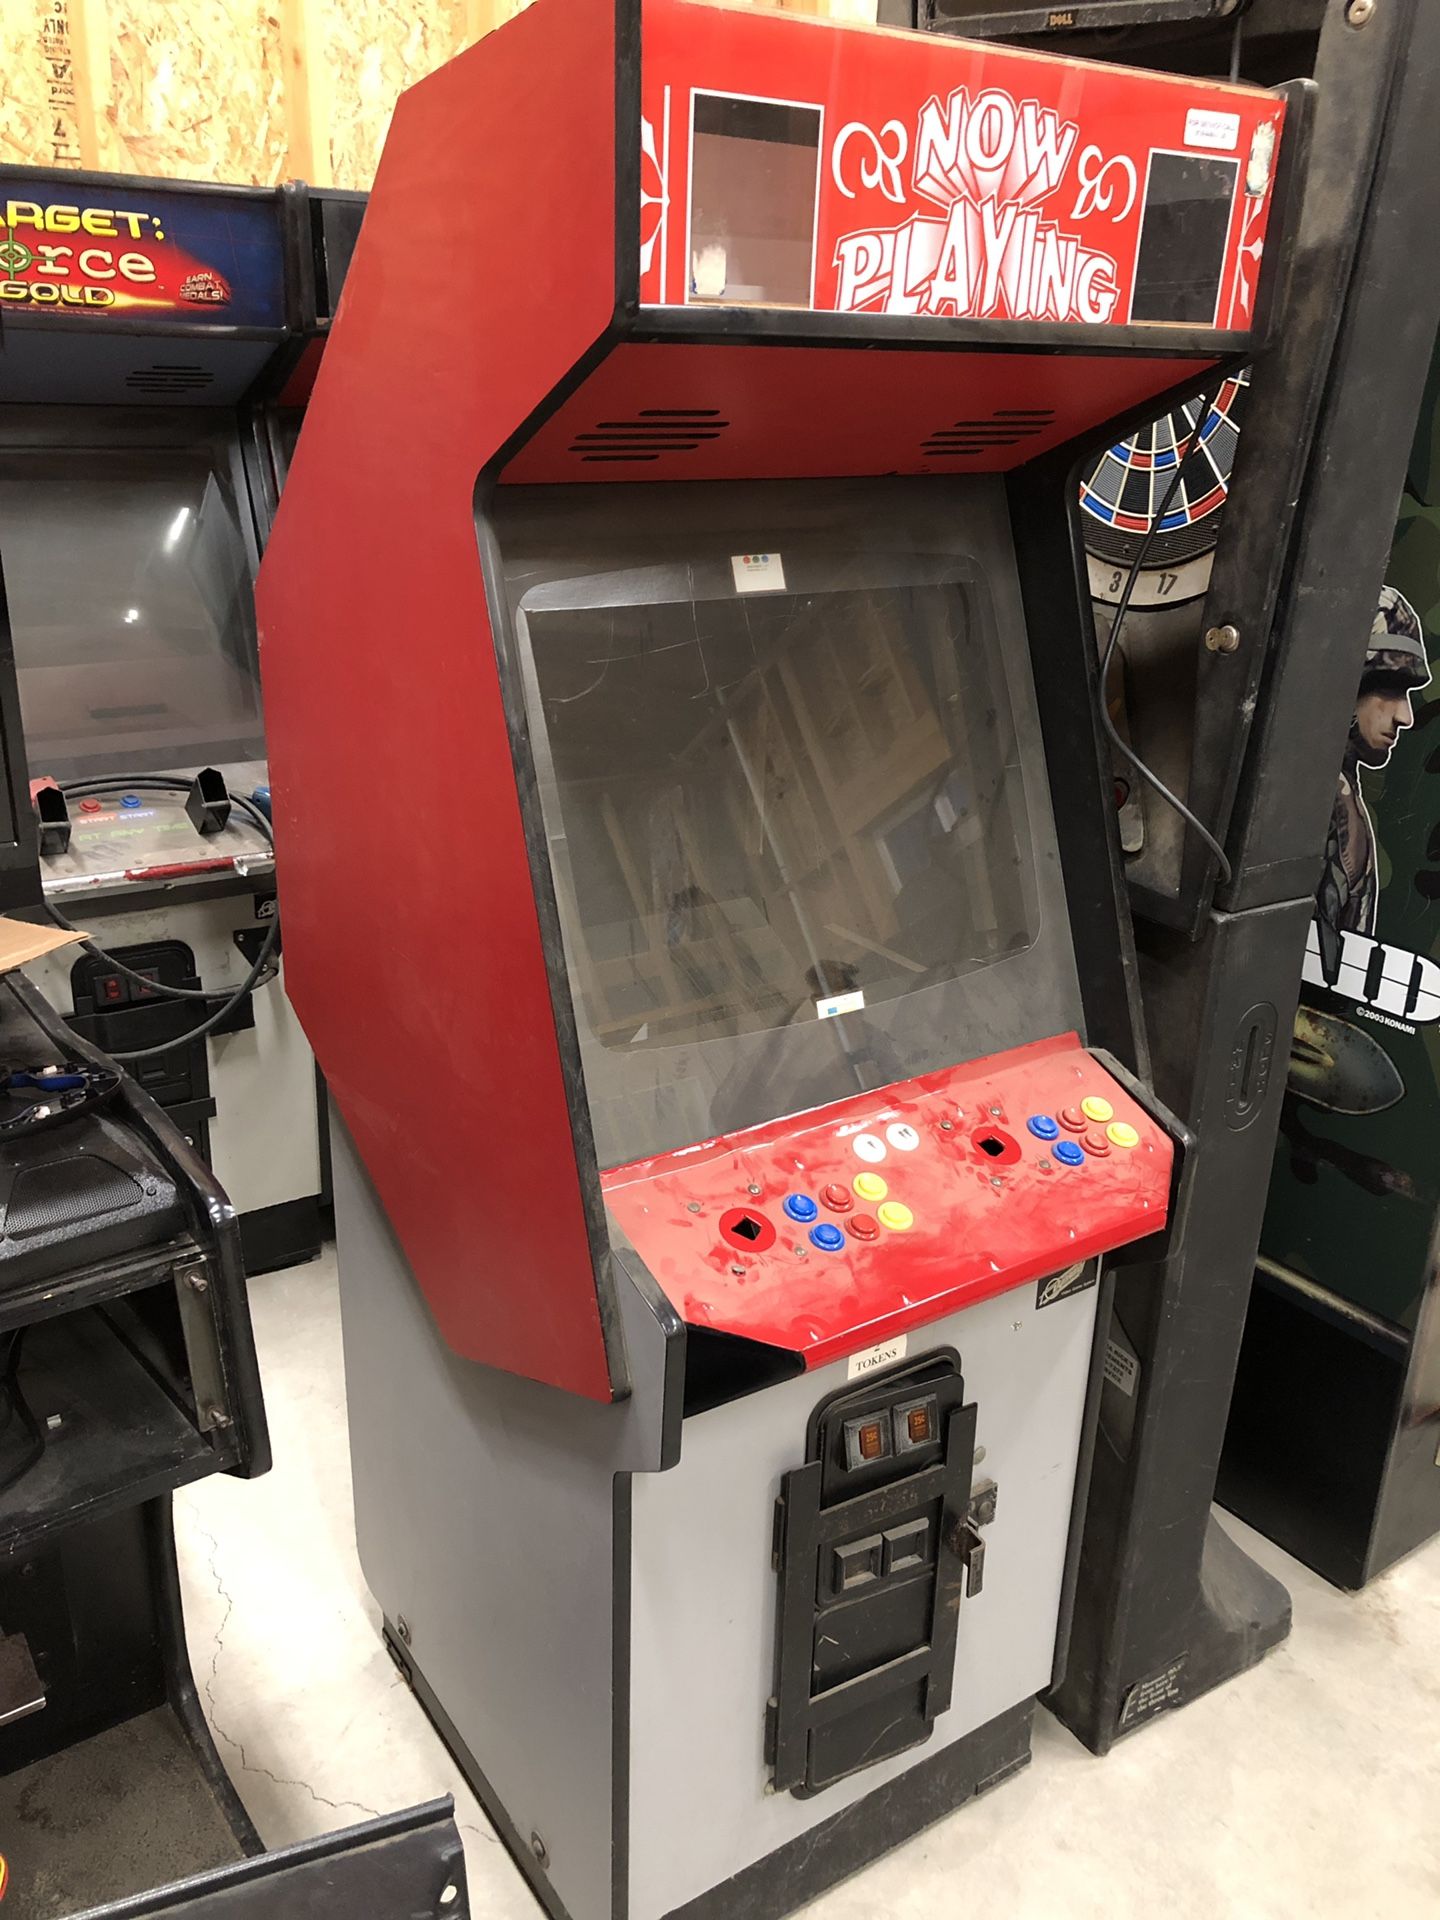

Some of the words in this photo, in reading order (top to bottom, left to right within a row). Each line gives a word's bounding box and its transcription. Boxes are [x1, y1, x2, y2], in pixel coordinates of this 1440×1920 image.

[912, 85, 1080, 207] NOW
[0, 199, 165, 241] RGET:
[180, 280, 223, 292] COMBAT
[186, 272, 213, 283] EARN
[0, 280, 115, 308] GOLD
[1109, 571, 1122, 593] 3
[1156, 572, 1178, 595] 17
[1384, 1017, 1416, 1036] KONAMI
[855, 1347, 897, 1371] TOKENS
